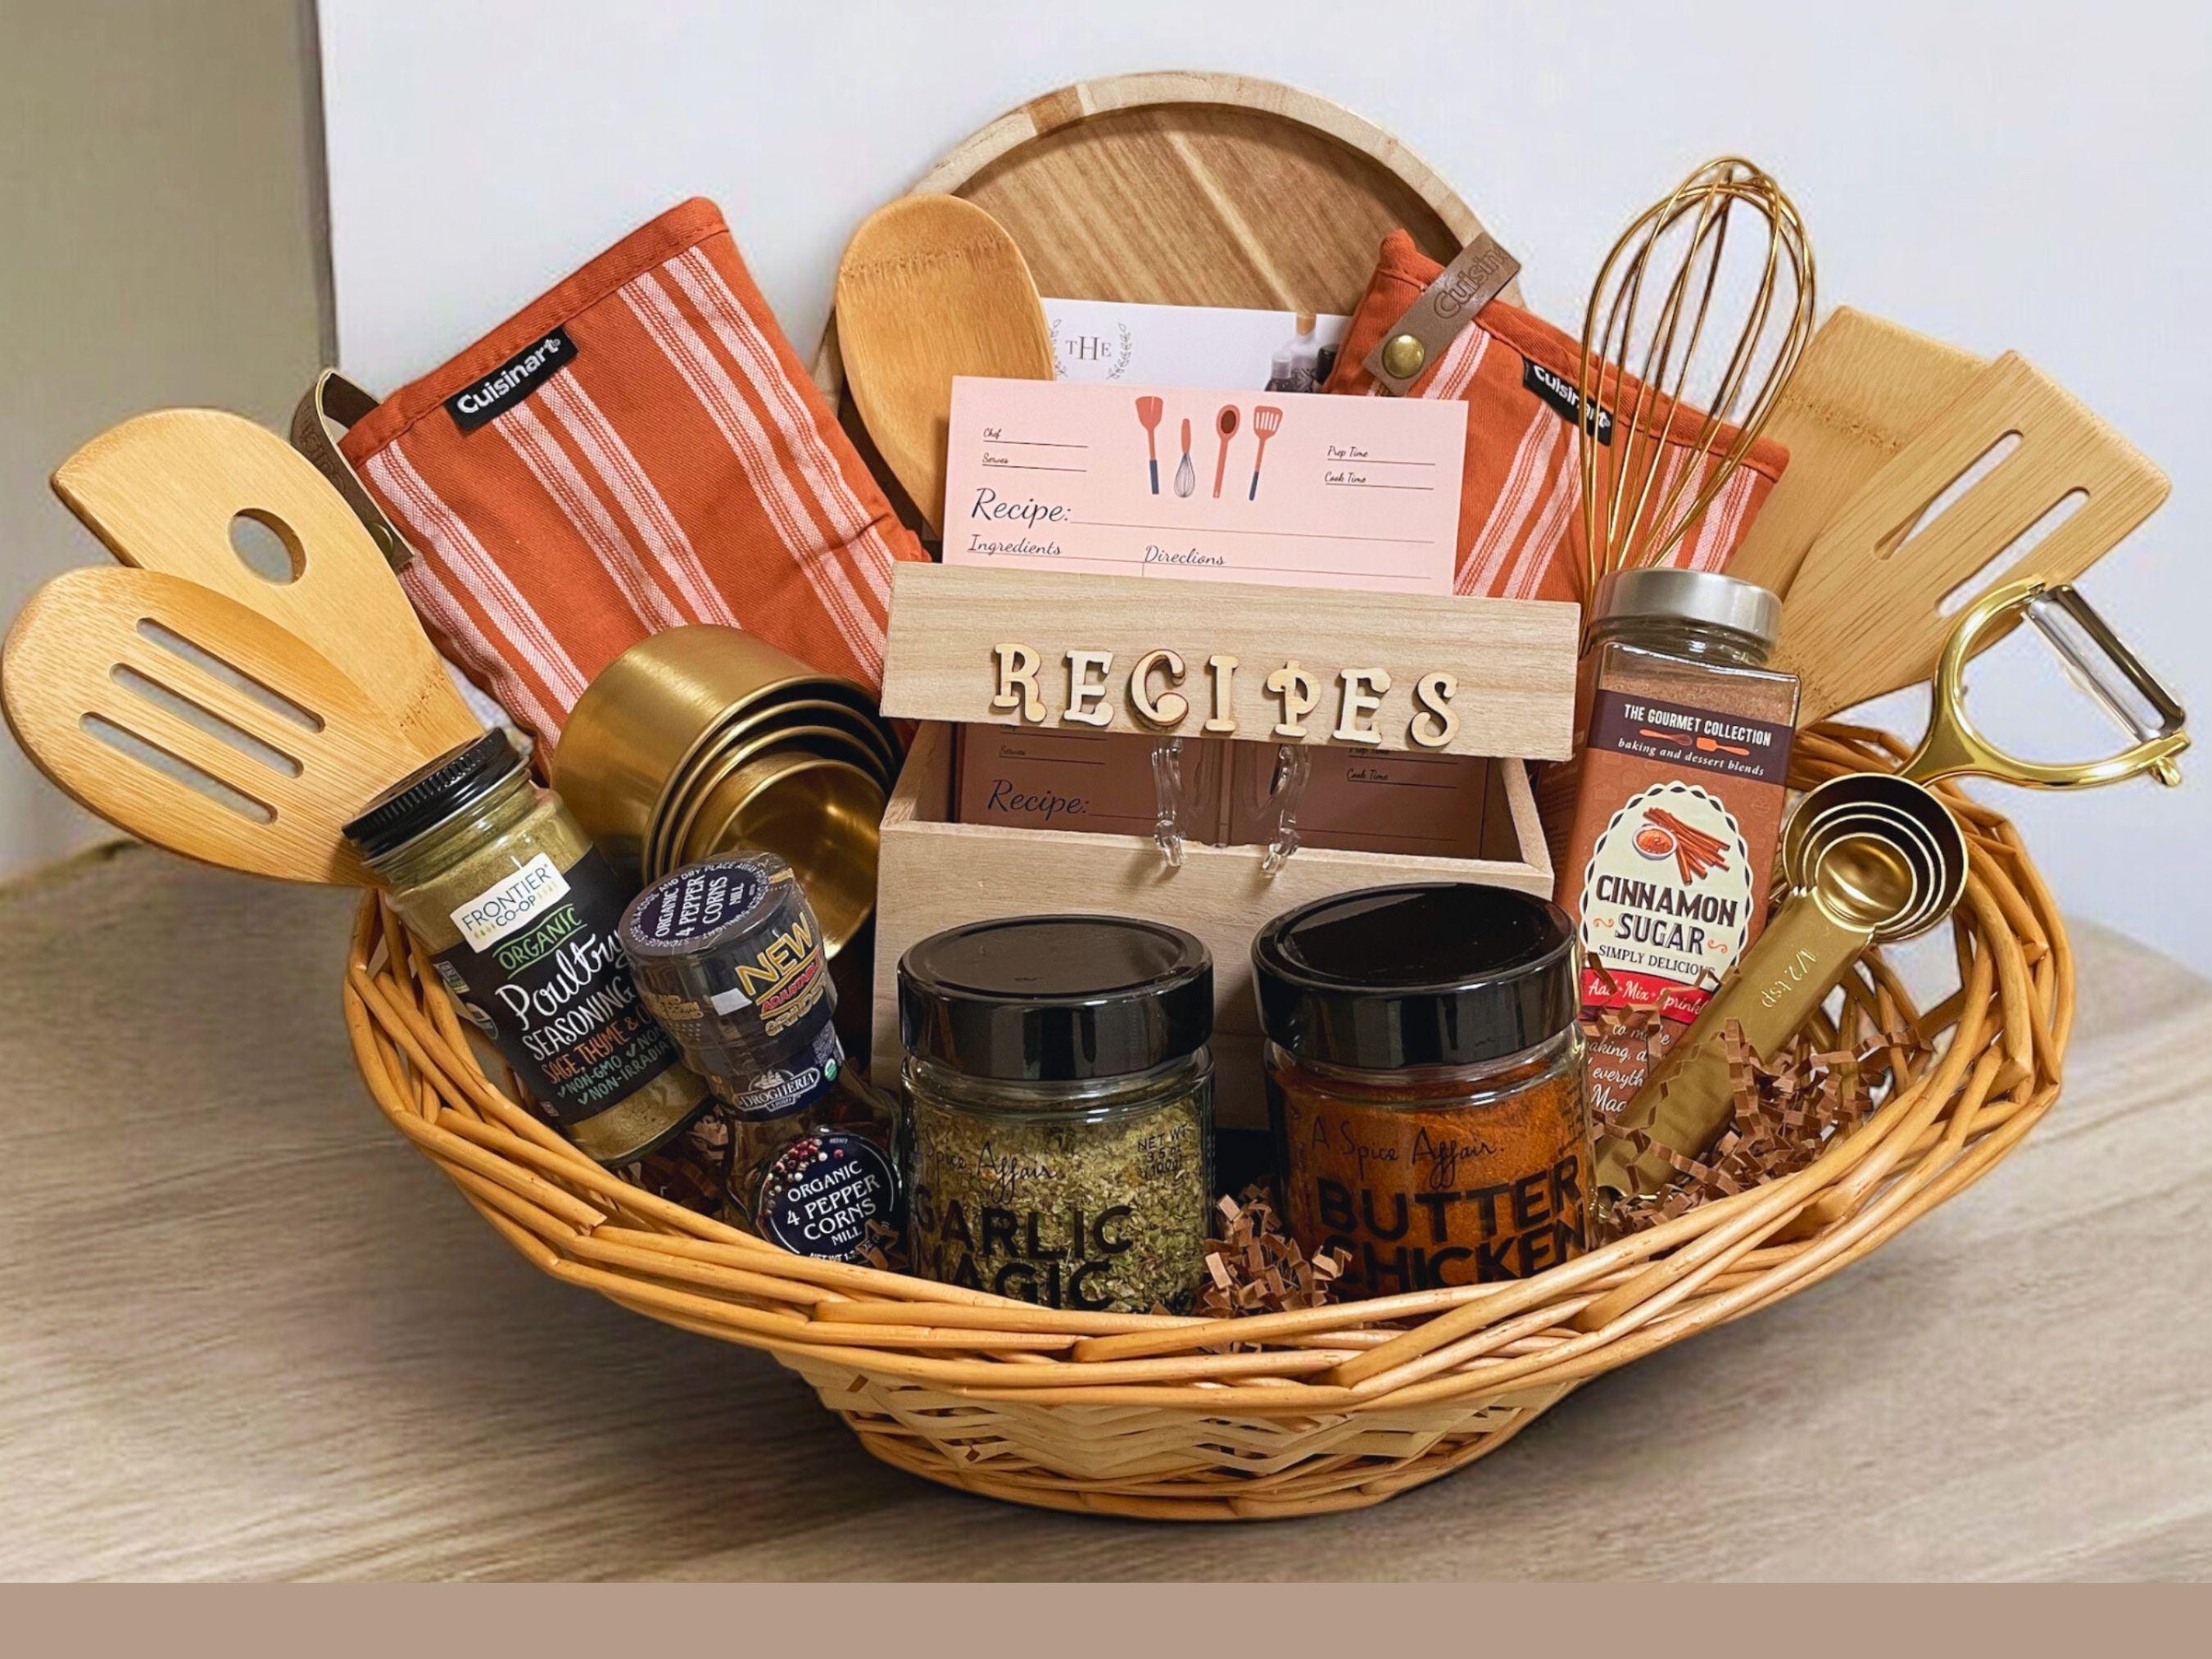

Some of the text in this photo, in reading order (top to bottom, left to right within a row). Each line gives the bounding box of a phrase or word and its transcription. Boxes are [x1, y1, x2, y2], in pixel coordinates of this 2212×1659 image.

[1064, 336, 1112, 360] THE
[1349, 446, 1368, 458] Time
[1348, 472, 1367, 483] Time
[971, 487, 1072, 529] Recipe:
[968, 534, 1063, 556] Ingredients
[1145, 545, 1226, 565] Directions
[992, 641, 1462, 748] RECIPES
[1624, 704, 1771, 746] THE GOURMET COLLECTION
[1617, 737, 1765, 777] baking and dessert blends
[987, 779, 1090, 821] Recipe:
[461, 866, 552, 931] FRONTIER
[495, 894, 537, 928] CO-OP
[655, 887, 680, 938] ORGANIC
[675, 875, 707, 937] 4 PEPPER
[702, 876, 728, 924] CORNS
[728, 882, 745, 906] MILL
[1596, 874, 1738, 928] CINNAMON
[498, 907, 582, 972] ORGANIC
[734, 911, 814, 997] NEW
[1598, 944, 1645, 965] SIMPLY
[1615, 912, 1707, 956] SUGAR
[494, 929, 632, 1031] Poultry
[1622, 980, 1650, 1002] Mix
[522, 976, 637, 1063] SEASONING
[542, 1016, 640, 1086] SAGE, THYME &
[565, 1054, 623, 1095] NON-GMO
[740, 1072, 815, 1108] DROGHERIA
[1138, 1132, 1166, 1153] NET
[1311, 1114, 1331, 1152] A
[1340, 1119, 1398, 1181] Spice
[786, 1174, 881, 1226] 4 PEPPER
[787, 1160, 863, 1203] ORGANIC
[1316, 1154, 1583, 1242] BUTTER
[804, 1198, 877, 1240] CORNS
[831, 1226, 863, 1247] MILL
[915, 1184, 1135, 1260] GARLIC
